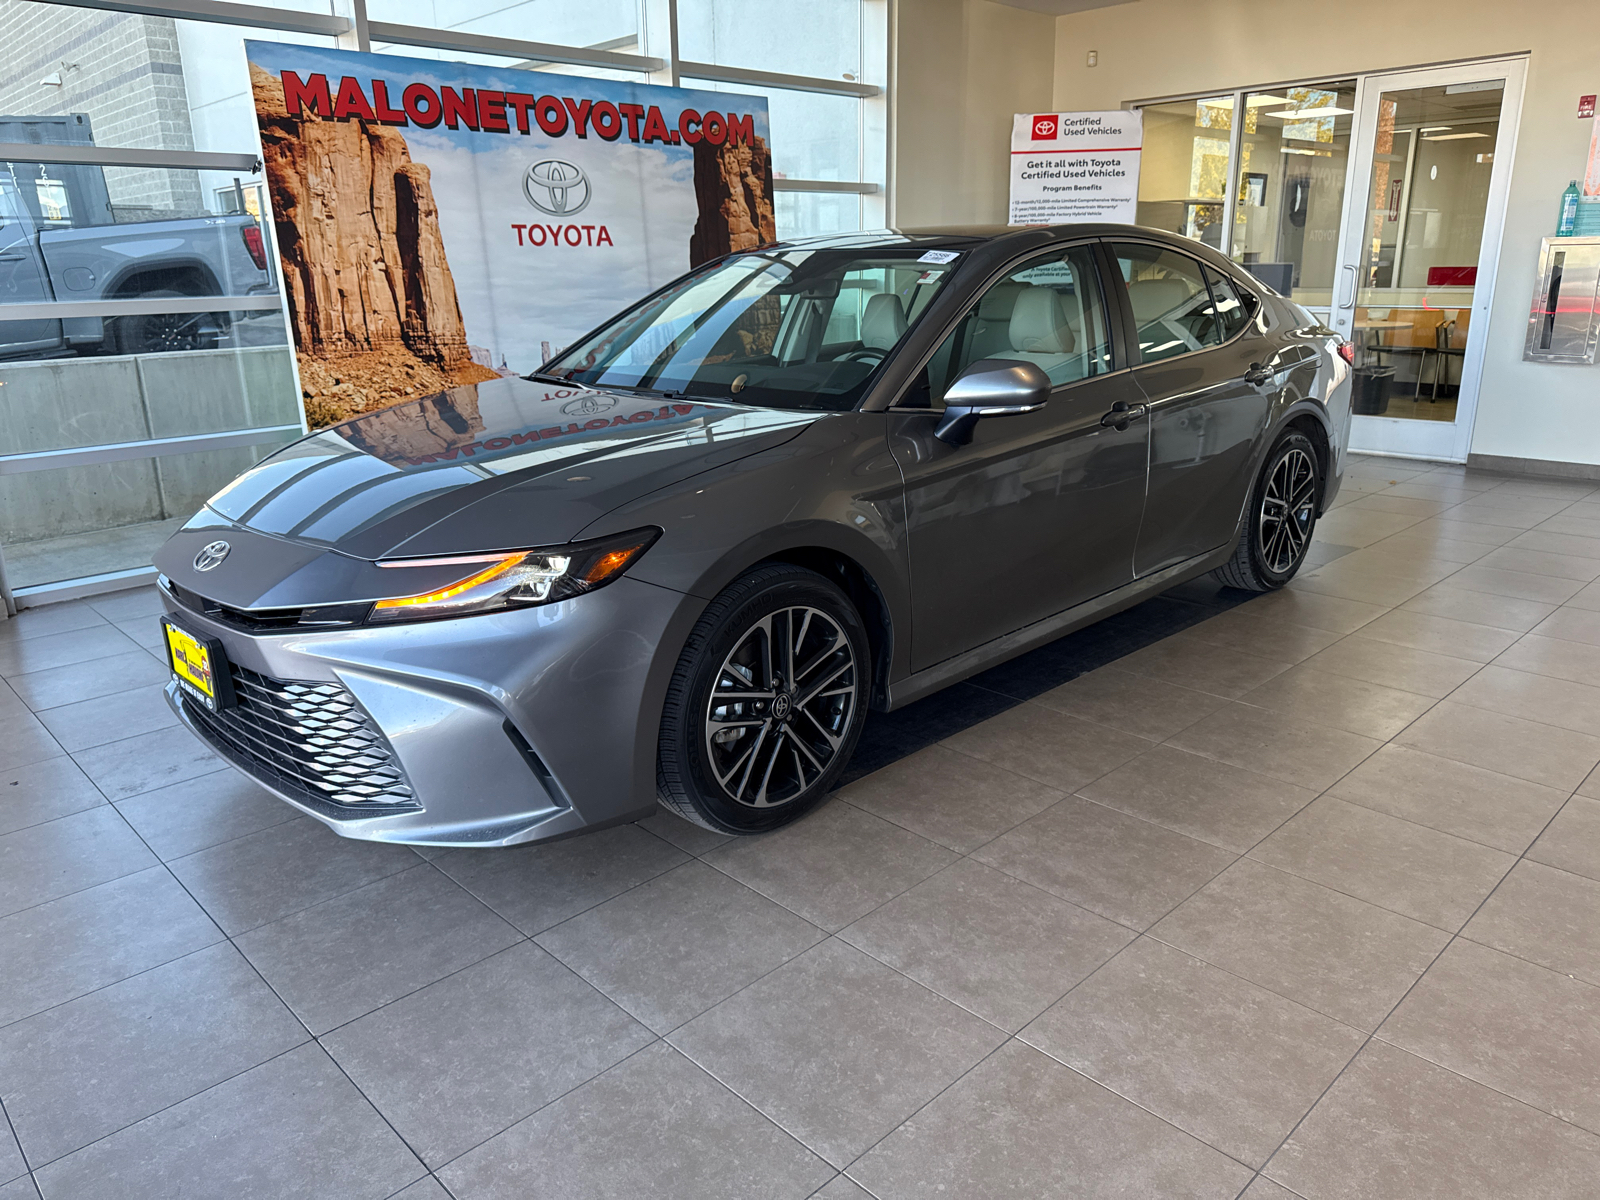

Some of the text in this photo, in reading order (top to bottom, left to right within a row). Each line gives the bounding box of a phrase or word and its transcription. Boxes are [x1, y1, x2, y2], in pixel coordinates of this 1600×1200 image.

[281, 70, 754, 147] MALONETOYOTA.COM
[1064, 118, 1101, 126] Certified
[1046, 160, 1052, 168] it
[1090, 159, 1121, 168] Toyota
[1021, 169, 1125, 179] Certified Used Vehicles
[512, 224, 613, 247] TOYOTA
[724, 593, 772, 637] KUMHO
